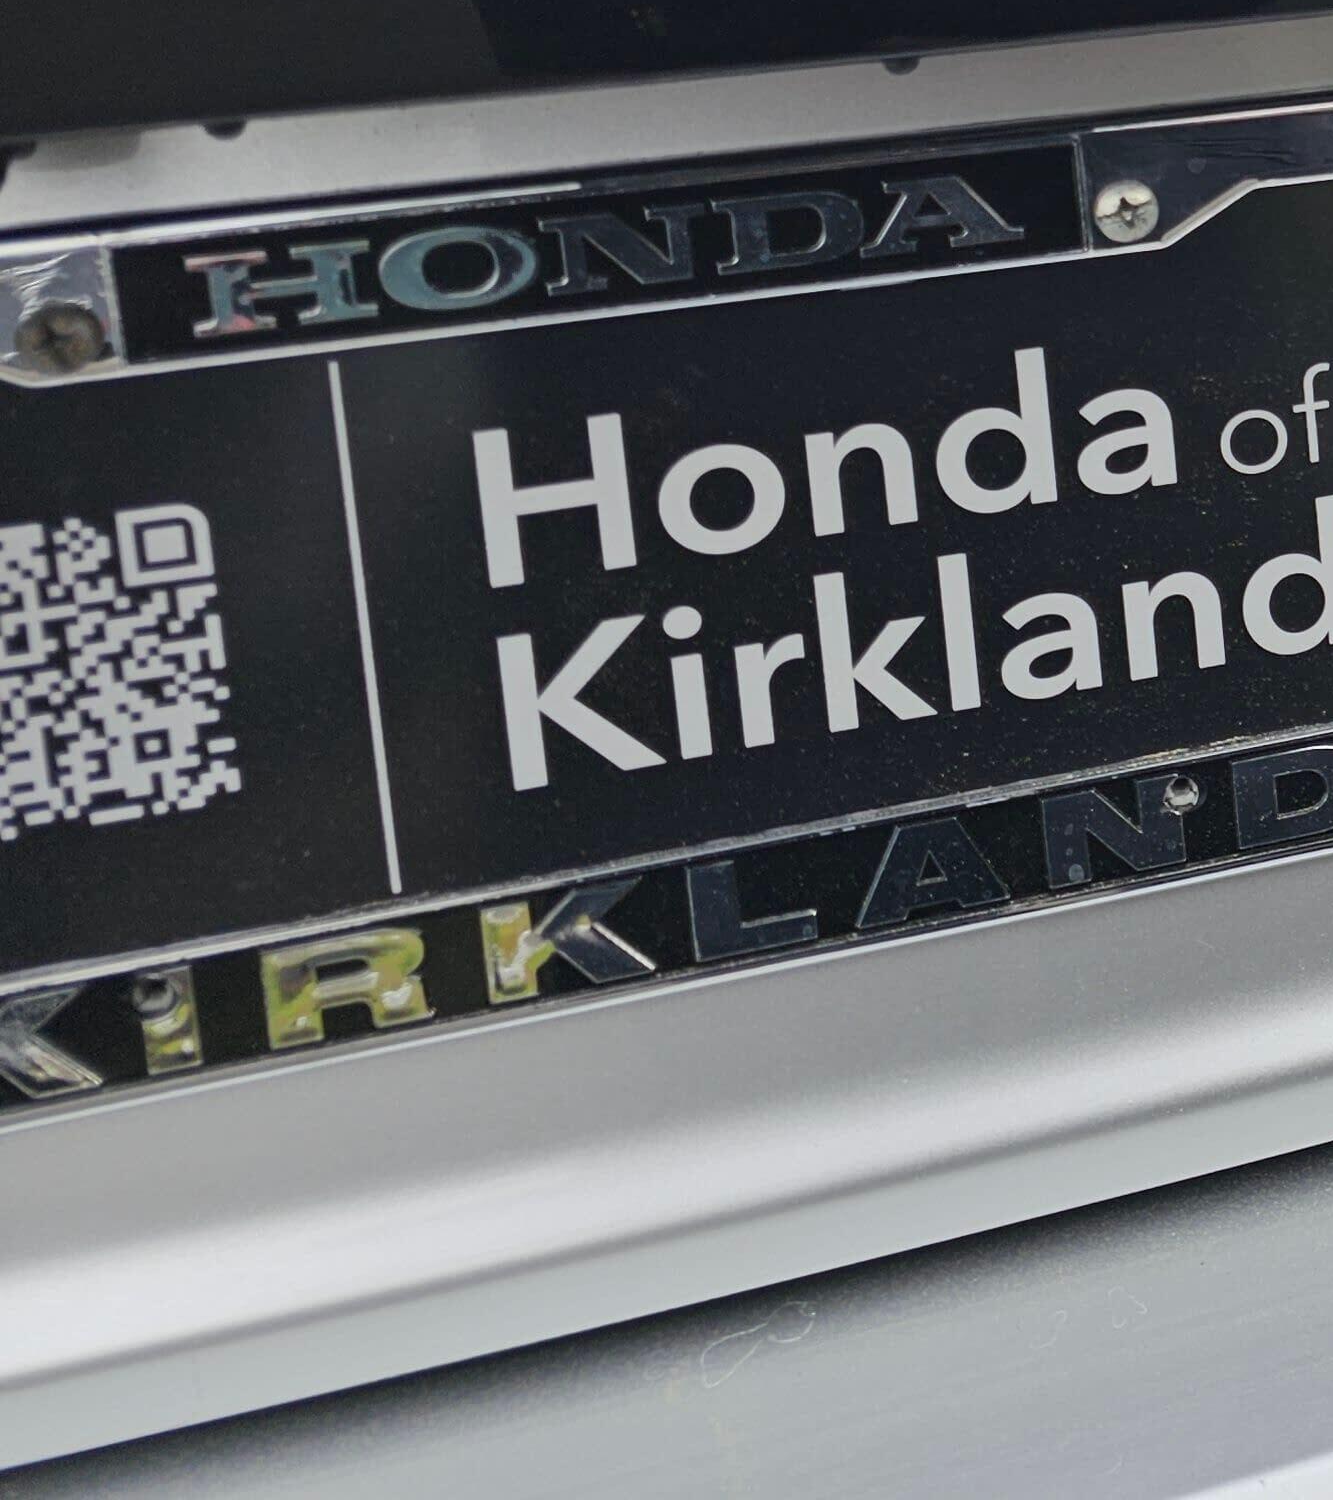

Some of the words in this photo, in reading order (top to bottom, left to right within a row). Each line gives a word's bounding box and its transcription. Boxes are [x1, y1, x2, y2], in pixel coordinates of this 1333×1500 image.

[183, 174, 1025, 338] HONDA
[472, 346, 1178, 590] Honda
[1219, 362, 1331, 475] of
